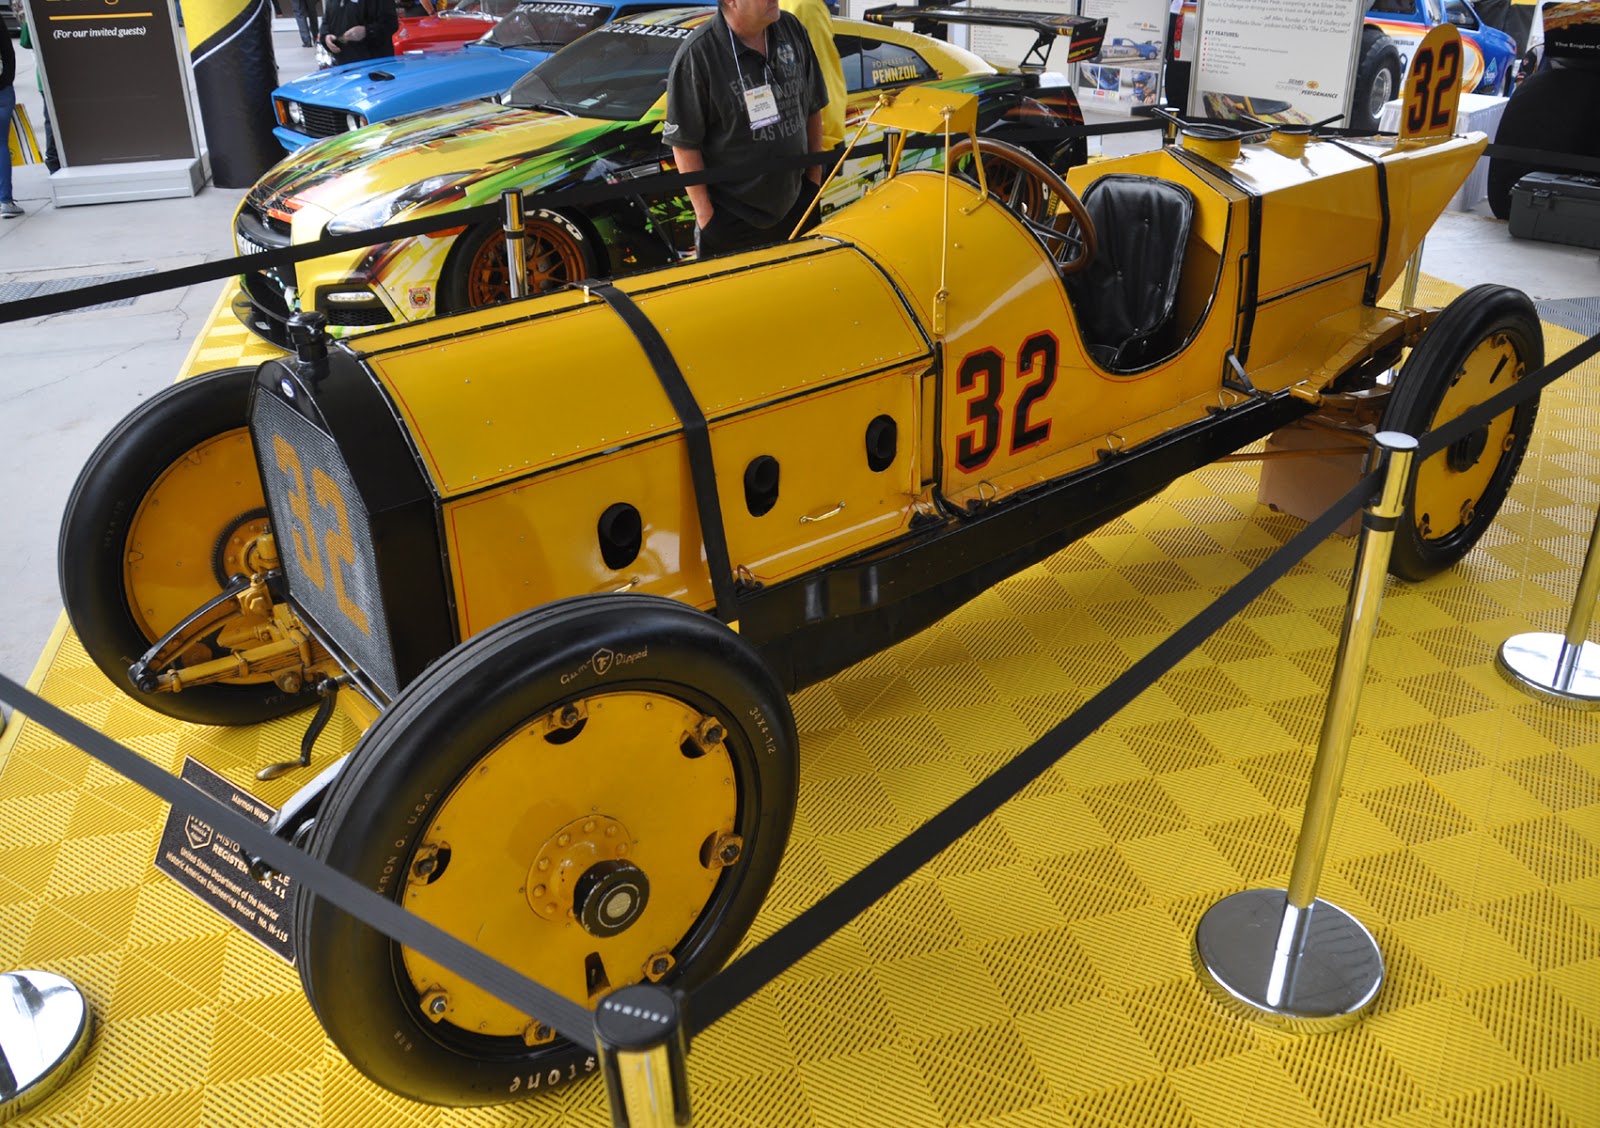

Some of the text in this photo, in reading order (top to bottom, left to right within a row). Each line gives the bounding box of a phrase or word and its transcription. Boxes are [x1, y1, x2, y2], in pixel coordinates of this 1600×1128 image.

[544, 4, 600, 17] GALLERY
[53, 26, 146, 39] (For our invited guests)
[628, 25, 694, 39] GALLE
[1569, 42, 1595, 50] Engine
[872, 58, 904, 68] POWERED
[871, 64, 919, 85] PENNZOIL
[1301, 89, 1339, 99] PERFORMANCE
[1407, 37, 1461, 134] 32
[752, 125, 775, 142] LAS
[955, 329, 1060, 474] 32
[273, 433, 371, 638] 32
[615, 645, 648, 666] Dipped
[231, 793, 269, 823] Marmon Wasp
[215, 832, 240, 853] HISTO
[180, 846, 279, 921] United States Department of the Interior
[375, 856, 398, 895] KRON
[165, 851, 185, 869] Historic
[184, 864, 208, 886] American
[206, 880, 237, 908] Engineering
[236, 901, 256, 920] Record
[257, 916, 267, 930] No.
[275, 886, 286, 899] 11
[509, 1056, 596, 1093] stone
